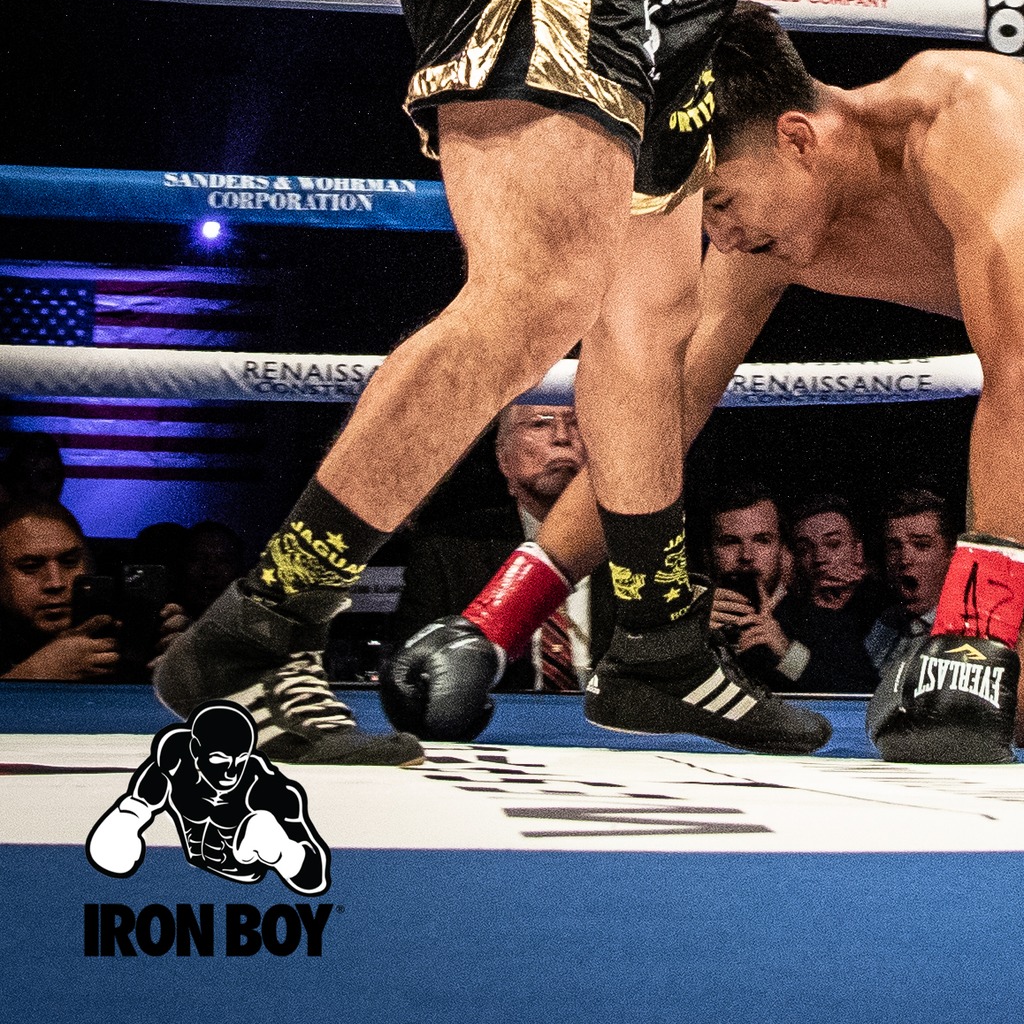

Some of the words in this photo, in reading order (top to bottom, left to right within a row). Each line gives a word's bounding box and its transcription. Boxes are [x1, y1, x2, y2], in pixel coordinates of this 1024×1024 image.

[163, 172, 270, 189] SANDERS
[273, 175, 292, 190] &
[208, 191, 373, 212] CORPORATION
[733, 375, 932, 393] RENAISSANCE
[914, 654, 1005, 709] EVERLAST
